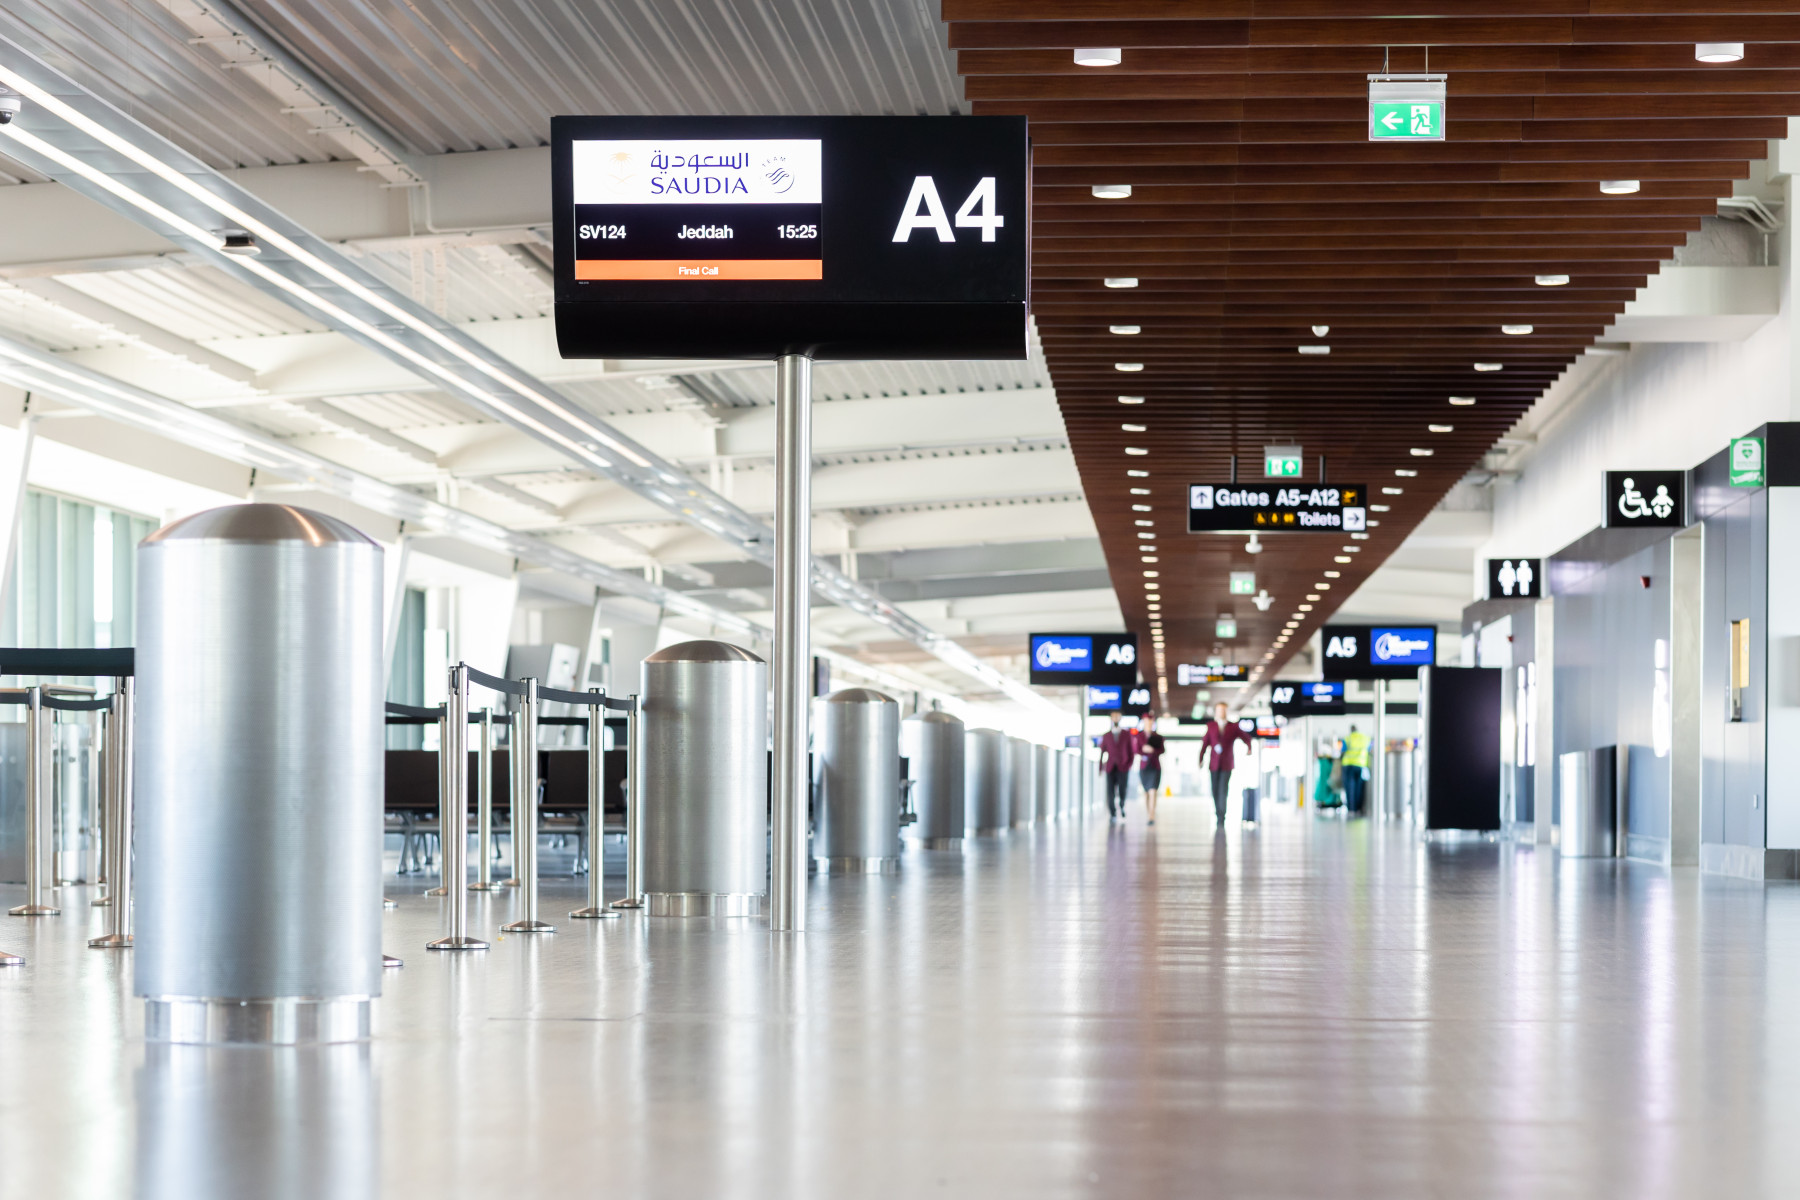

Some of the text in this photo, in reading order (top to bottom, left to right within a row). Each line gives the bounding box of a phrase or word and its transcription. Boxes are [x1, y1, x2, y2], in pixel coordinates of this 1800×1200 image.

[650, 150, 749, 174] السعودية
[651, 177, 749, 194] SAUDIA
[892, 176, 1005, 243] A4
[579, 224, 817, 239] SV124 Jeddah 15:25
[678, 267, 719, 276] Final Call
[1215, 489, 1340, 507] Gates A5-A12
[1297, 511, 1341, 527] Toilets
[1326, 636, 1358, 658] A5
